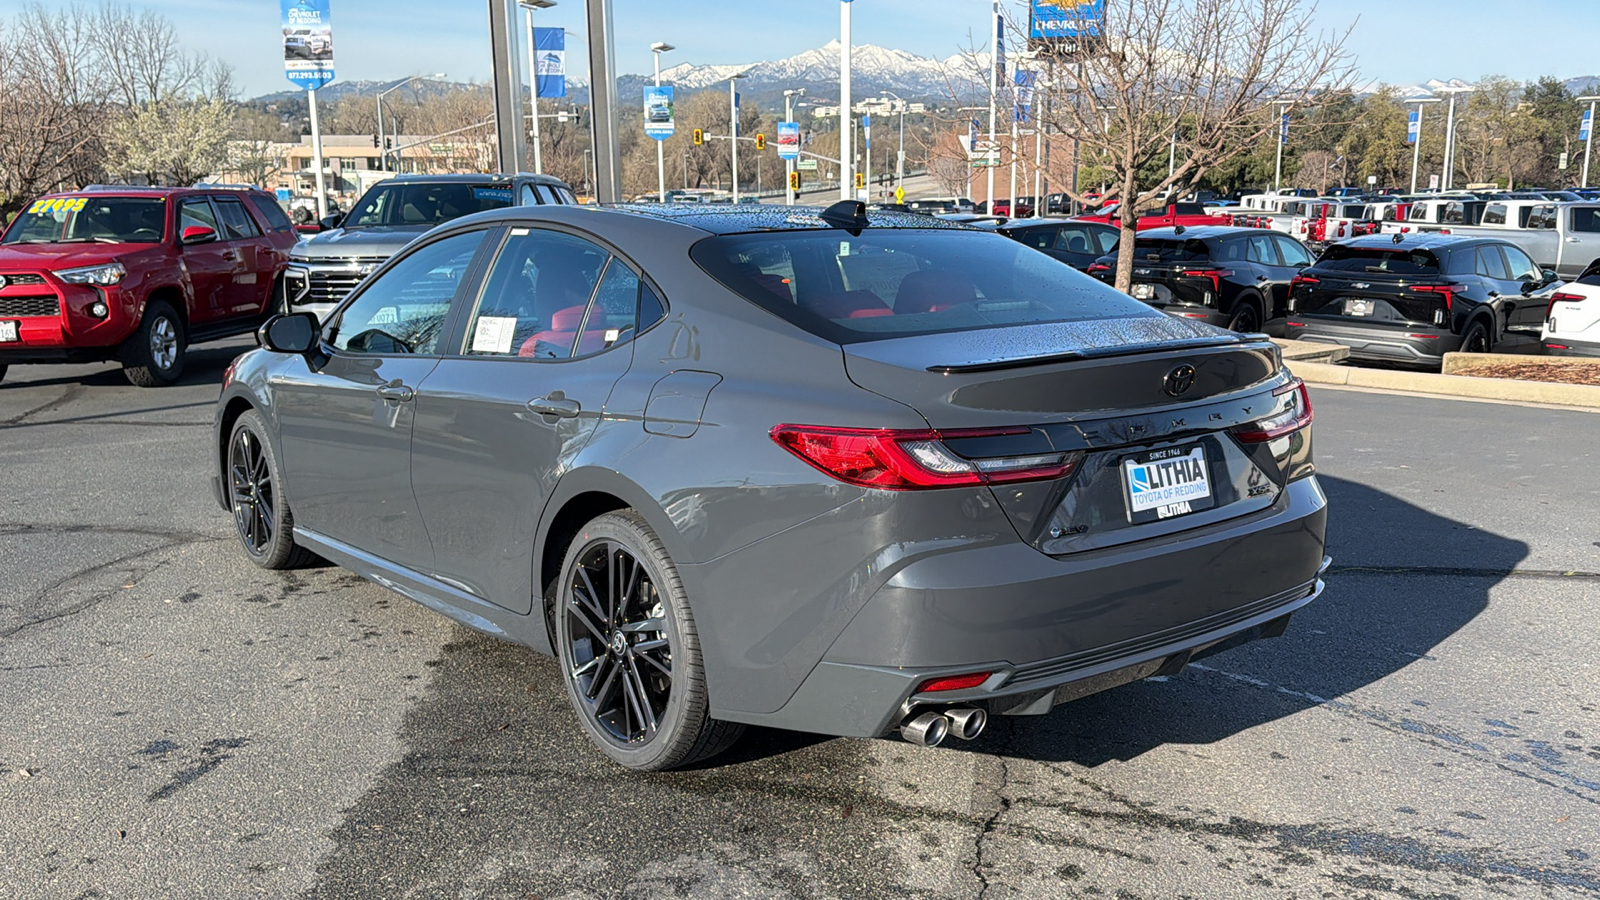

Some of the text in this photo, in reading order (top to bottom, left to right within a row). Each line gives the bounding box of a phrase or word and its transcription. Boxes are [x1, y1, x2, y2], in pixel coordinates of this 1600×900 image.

[1149, 450, 1168, 460] SINCE
[1146, 457, 1205, 490] LITHIA
[1133, 482, 1207, 505] TOYOTA OF REDDING
[1165, 501, 1193, 516] LITHIA
